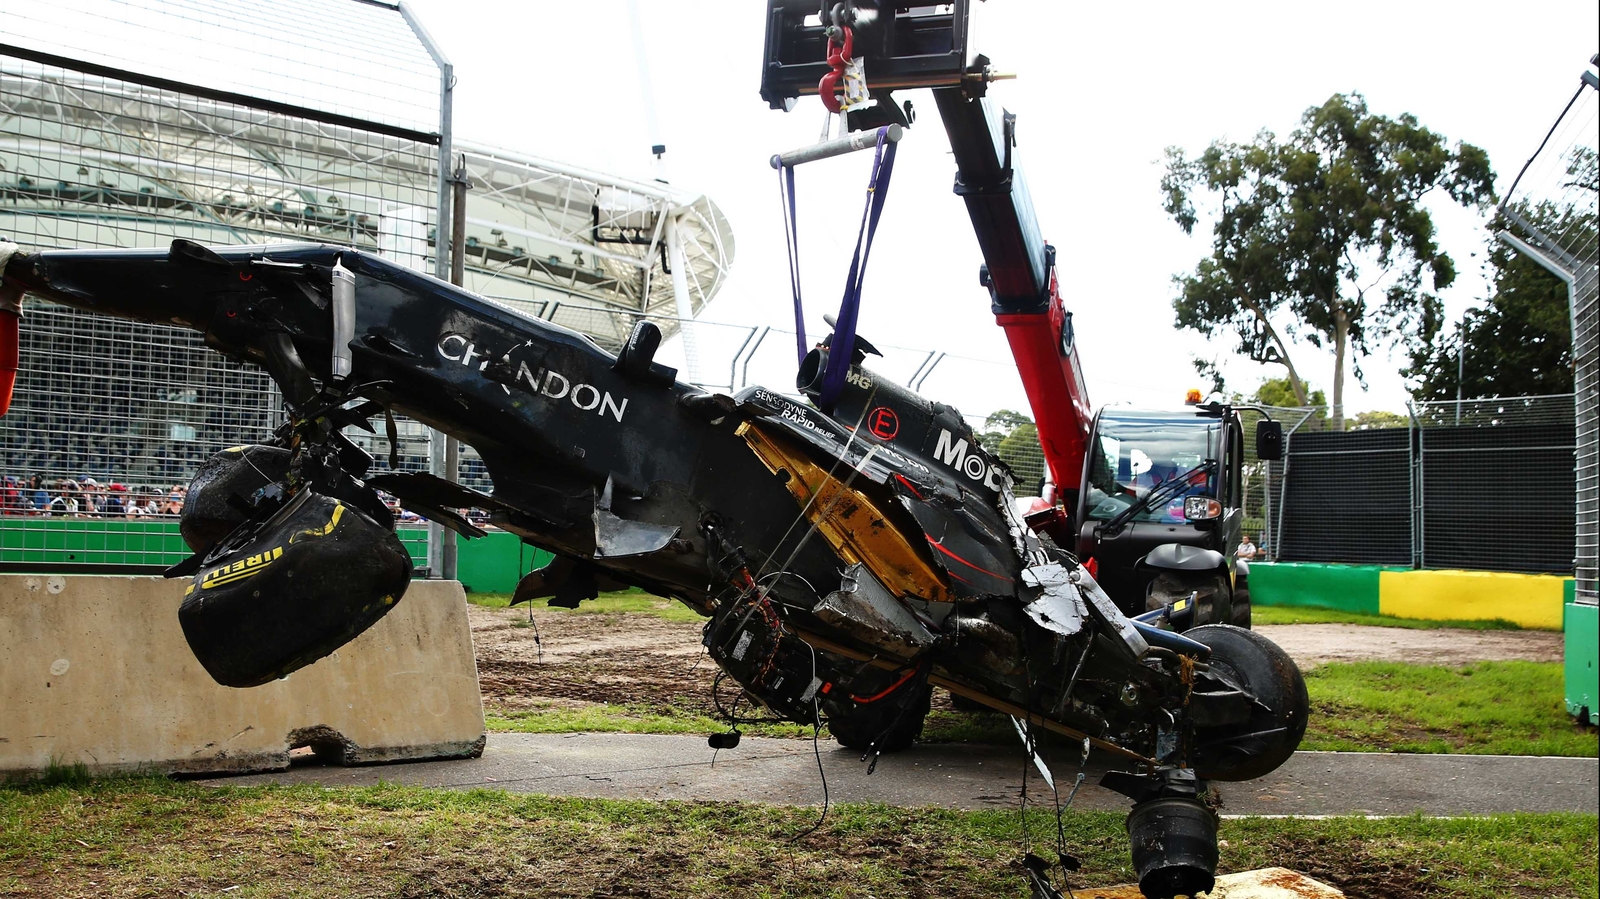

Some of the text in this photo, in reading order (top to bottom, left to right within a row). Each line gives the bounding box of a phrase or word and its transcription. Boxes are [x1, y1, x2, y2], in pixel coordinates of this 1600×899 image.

[755, 390, 808, 418] SENSODYNE
[781, 409, 836, 439] RAPID RELIEF
[873, 409, 897, 438] E
